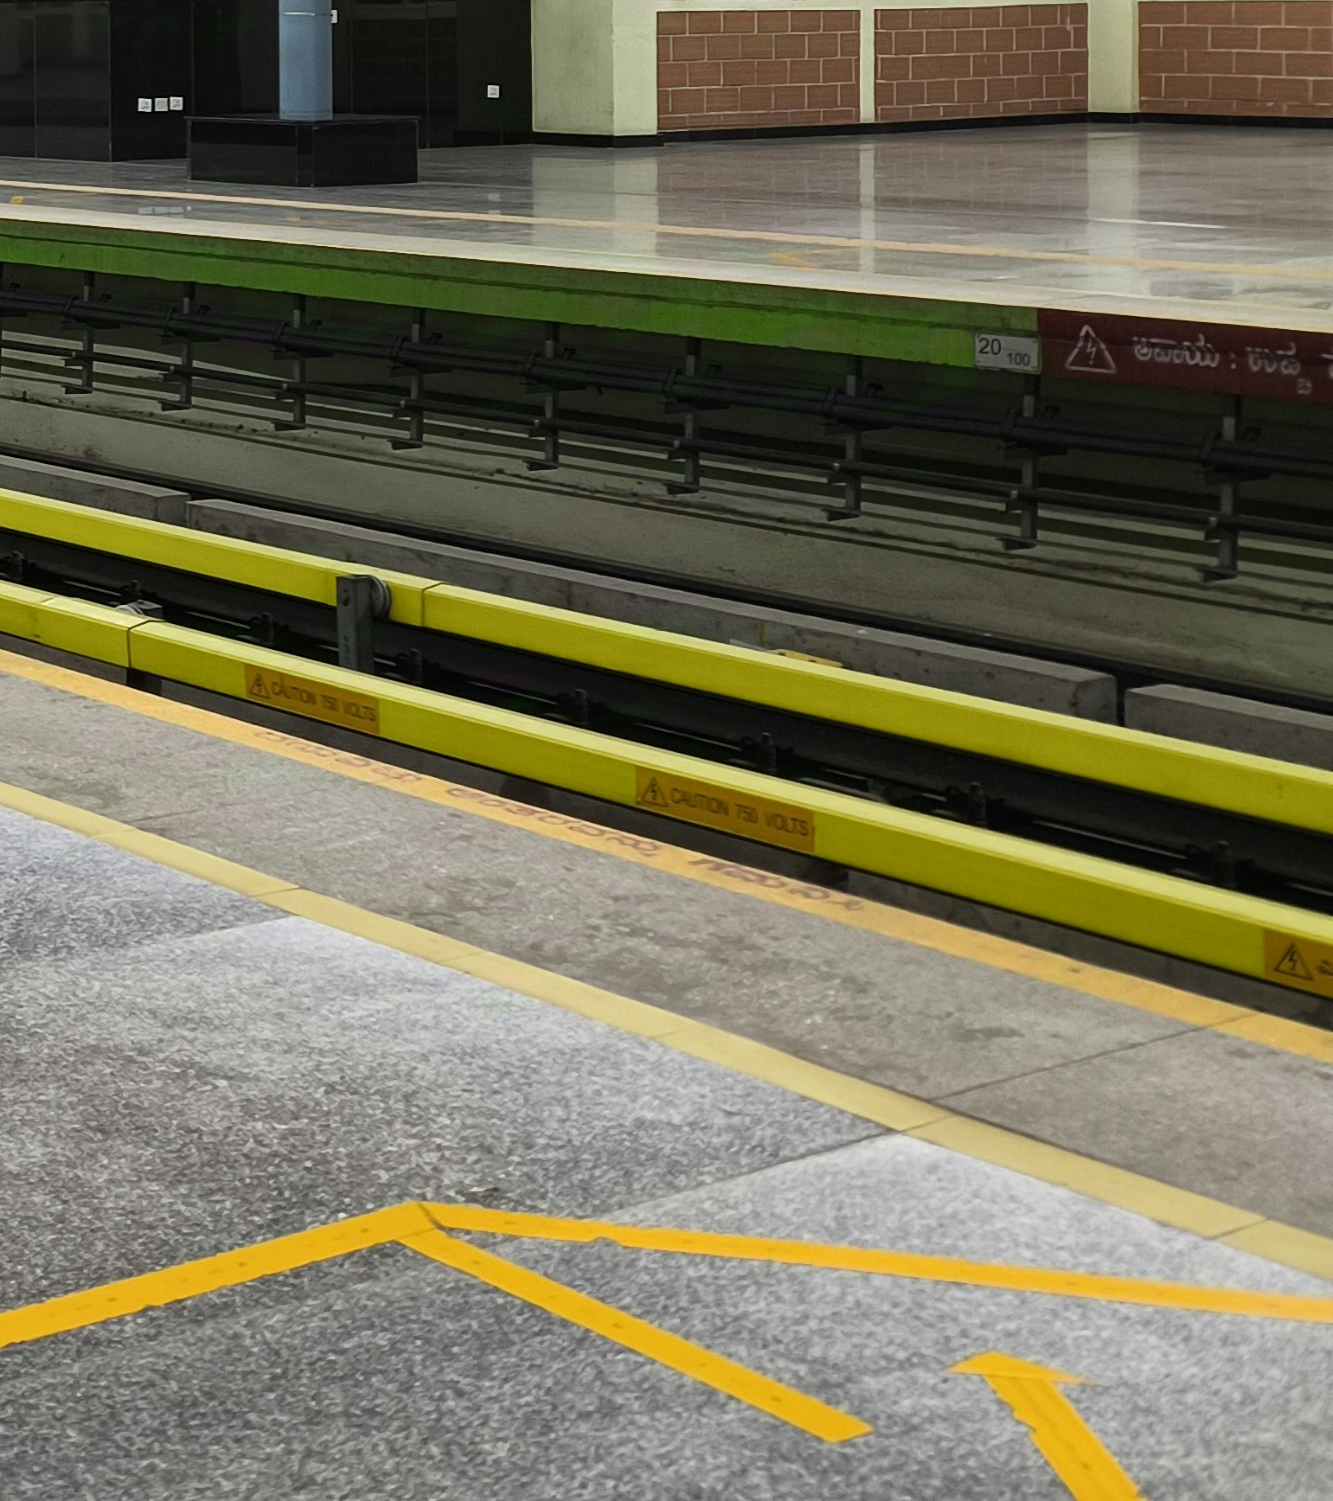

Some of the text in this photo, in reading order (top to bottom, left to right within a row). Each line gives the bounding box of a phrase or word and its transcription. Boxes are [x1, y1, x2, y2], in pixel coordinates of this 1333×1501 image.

[978, 337, 1001, 355] 20
[1007, 352, 1031, 367] 100
[271, 682, 317, 706] CAUTION
[670, 787, 810, 837] CAUTION 750 VOLTS
